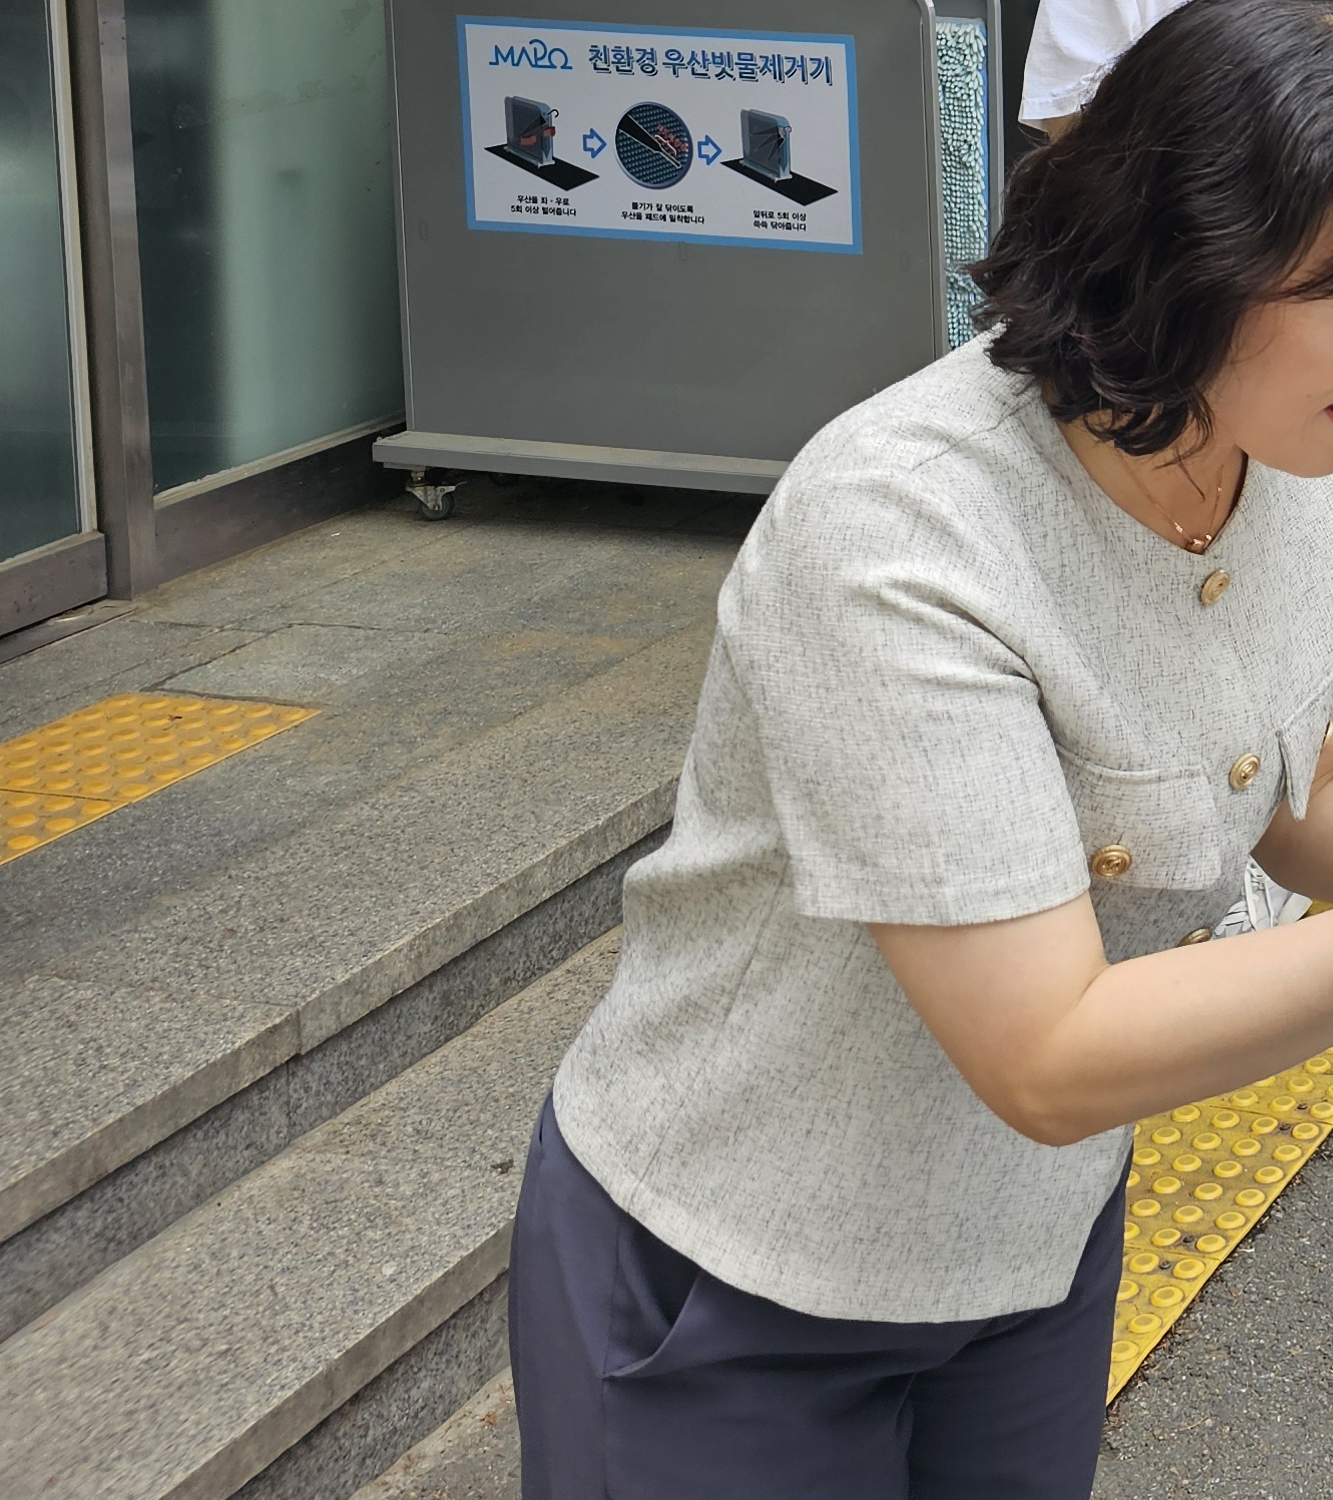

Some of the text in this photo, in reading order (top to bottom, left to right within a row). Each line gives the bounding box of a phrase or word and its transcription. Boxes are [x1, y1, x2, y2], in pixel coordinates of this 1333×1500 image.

[588, 44, 659, 78] 친환경
[662, 50, 834, 86] 우산빗물제거기
[517, 195, 538, 204] 우산을
[511, 205, 577, 217] 5회 이상 털어줍니다
[665, 204, 694, 214] 닦이도록
[621, 211, 705, 224] 우산을 패드에 밀착합니다
[753, 210, 807, 221] 앞뒤로 5회 이상
[770, 222, 807, 231] 닦아줍니다
